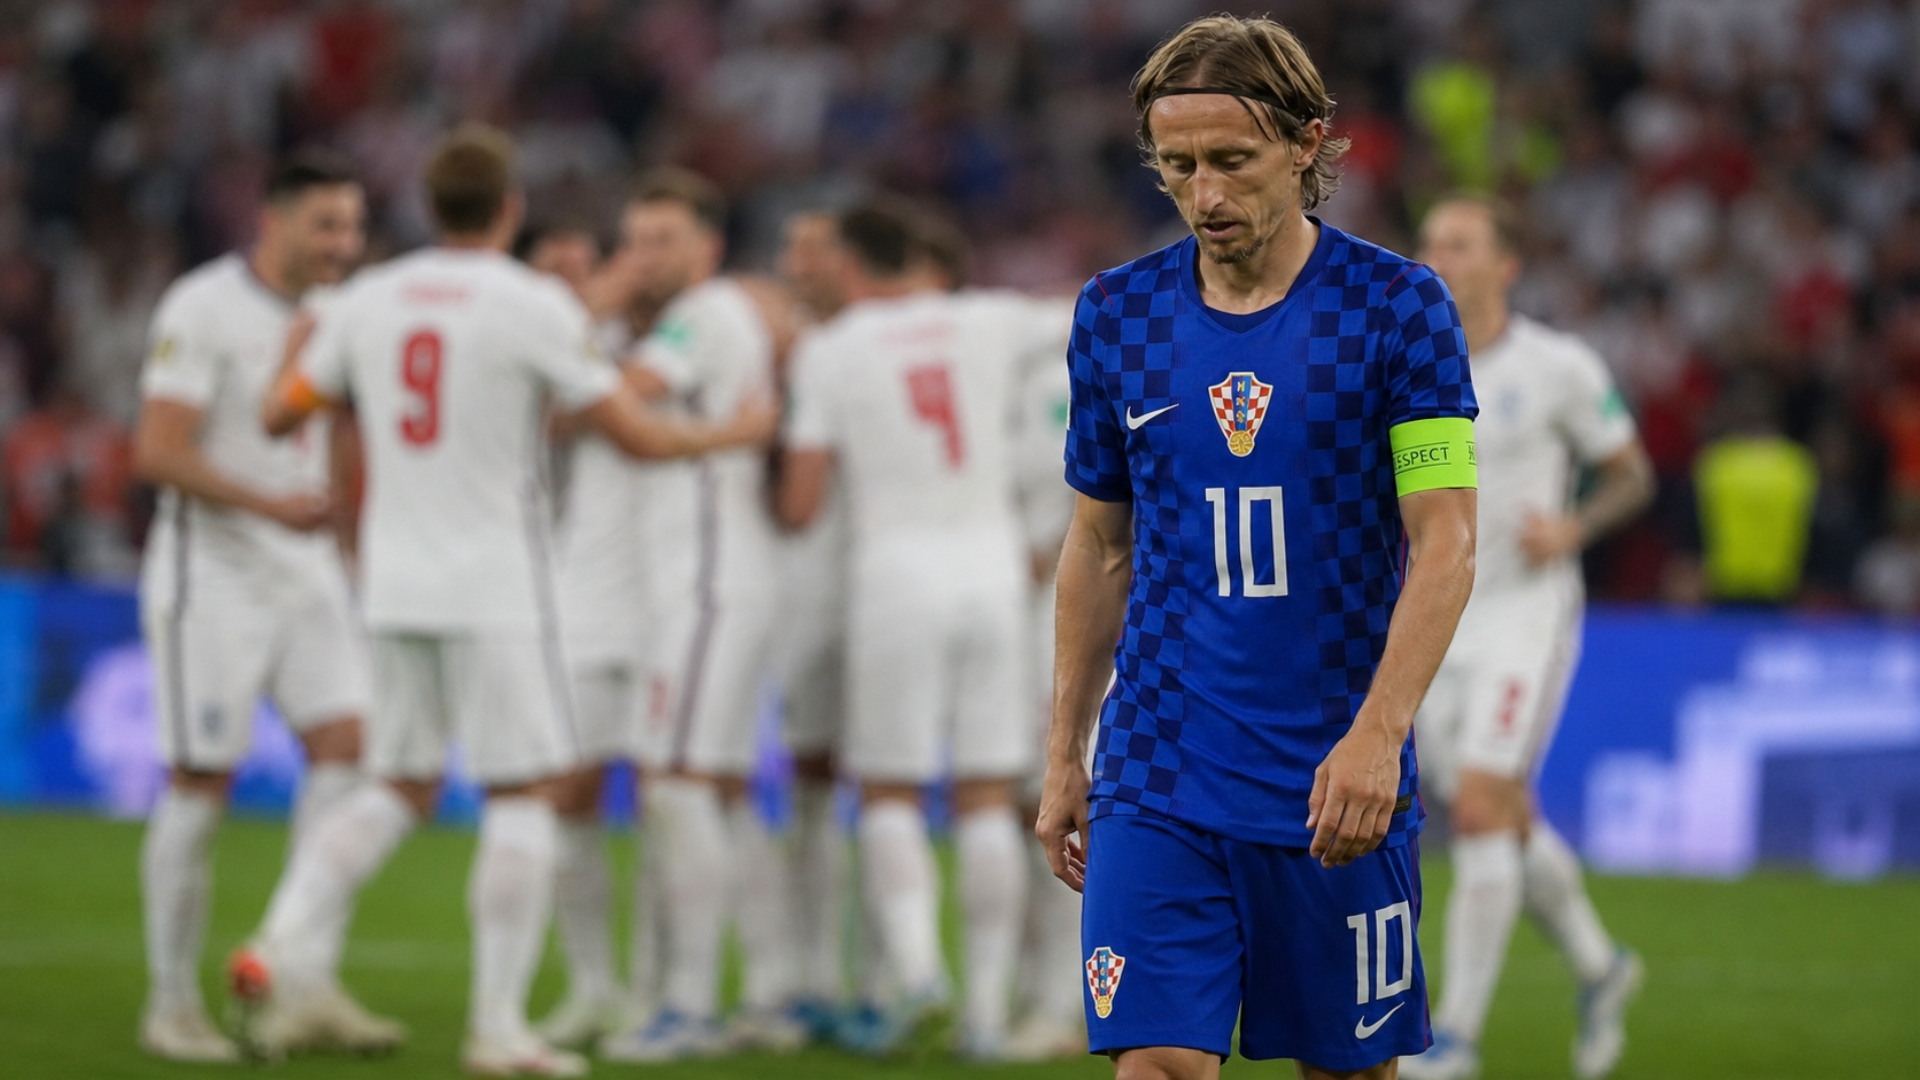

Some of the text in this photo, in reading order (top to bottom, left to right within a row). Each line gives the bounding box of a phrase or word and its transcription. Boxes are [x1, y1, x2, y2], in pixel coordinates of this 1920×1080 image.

[400, 329, 443, 449] 9
[1394, 446, 1449, 471] ESPECT
[1205, 486, 1289, 597] 10
[1347, 900, 1412, 1005] 10
